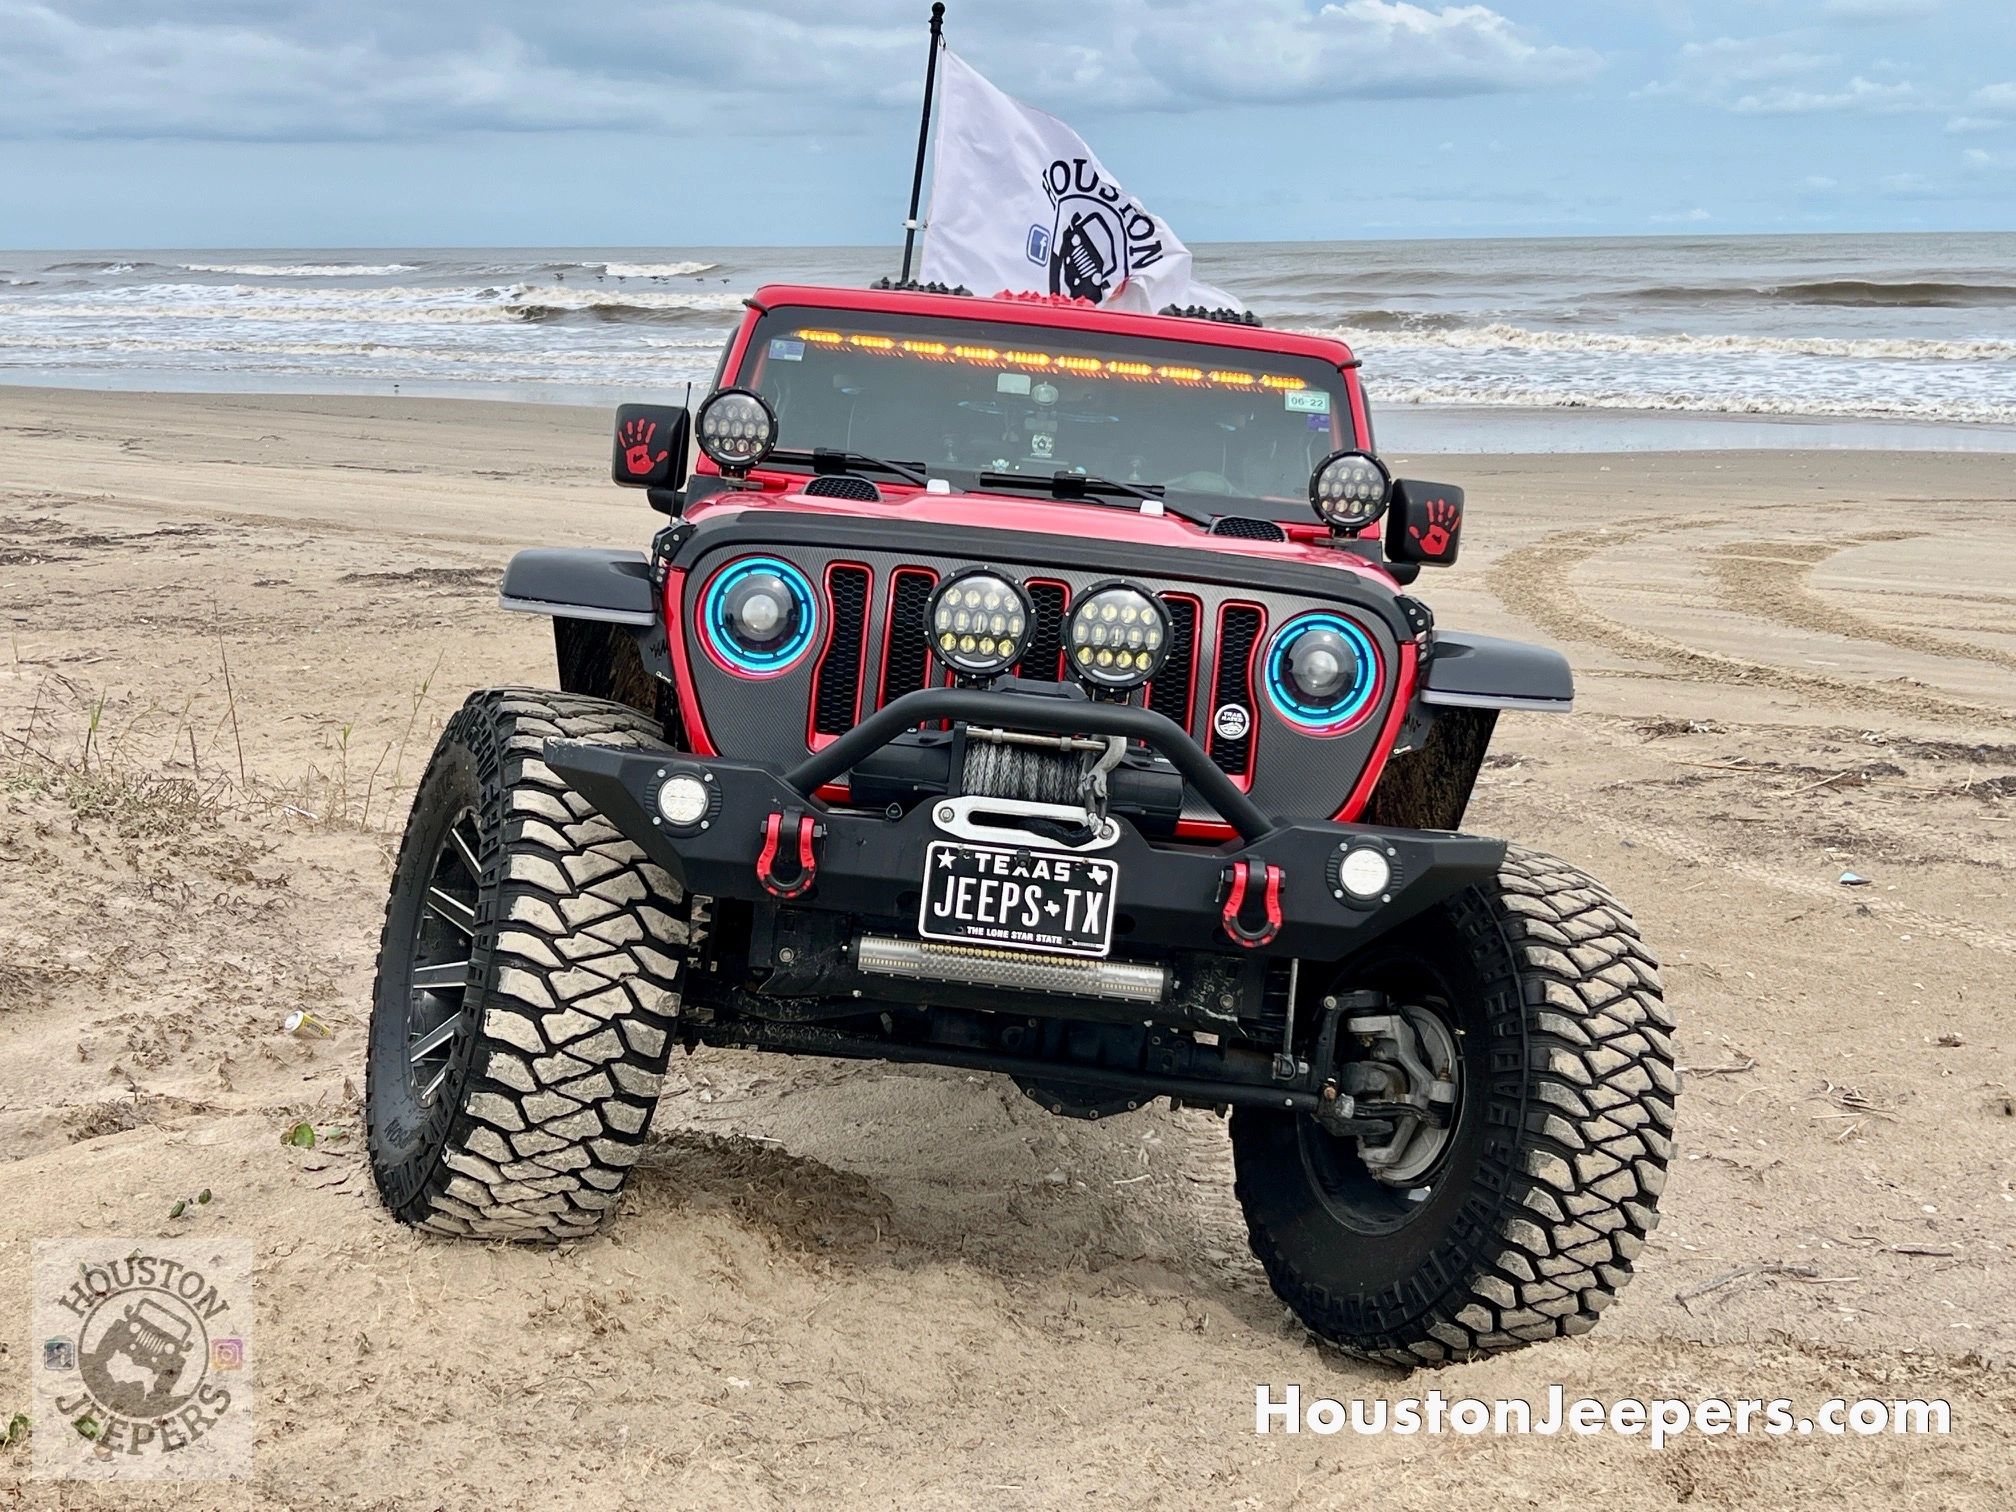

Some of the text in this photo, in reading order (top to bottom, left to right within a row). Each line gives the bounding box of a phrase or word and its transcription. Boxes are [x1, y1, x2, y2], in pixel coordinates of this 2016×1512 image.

[934, 875, 1104, 935] JEEPS TX
[967, 926, 1063, 944] THE LONE STAR STATE
